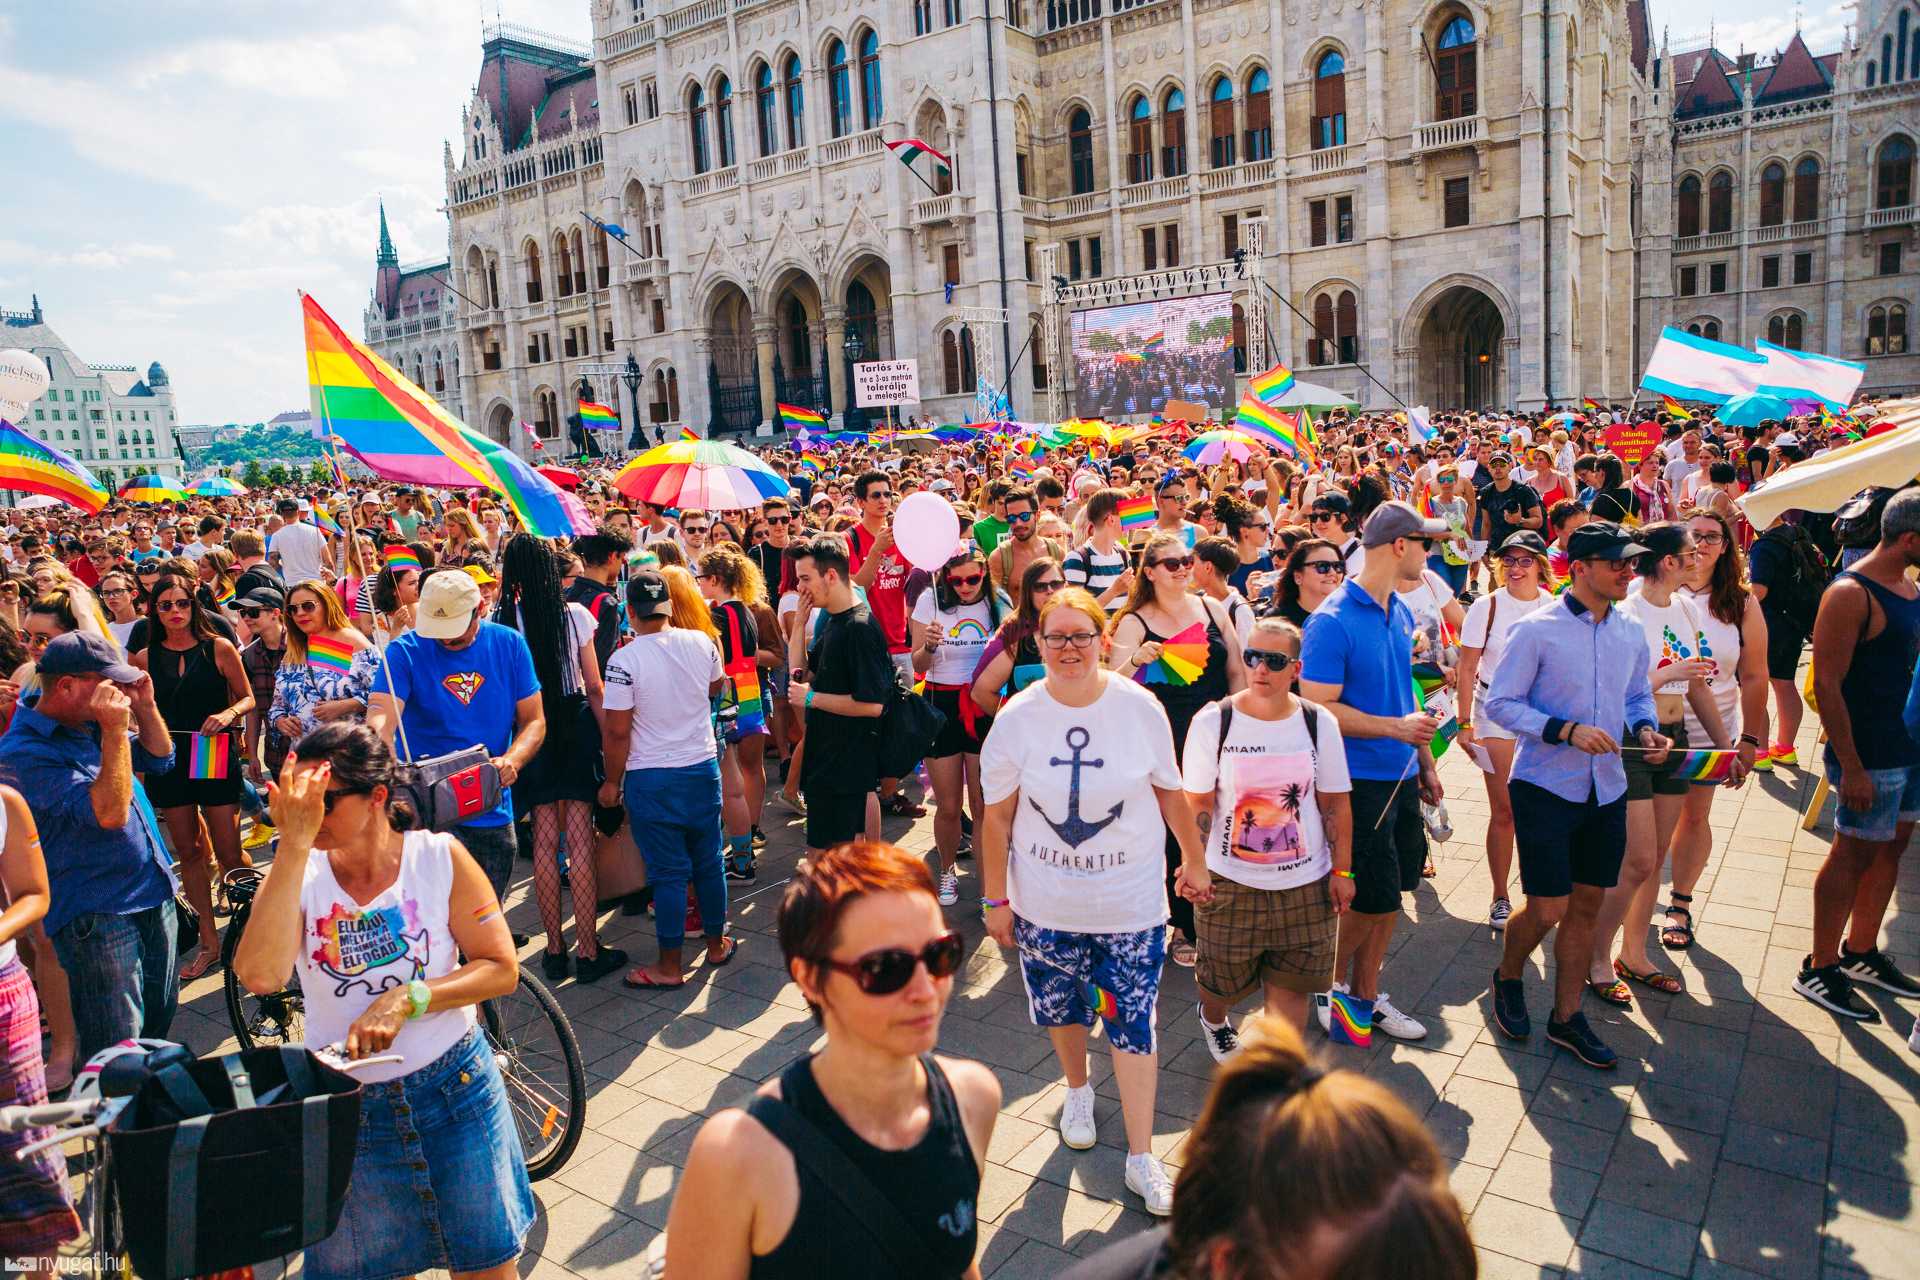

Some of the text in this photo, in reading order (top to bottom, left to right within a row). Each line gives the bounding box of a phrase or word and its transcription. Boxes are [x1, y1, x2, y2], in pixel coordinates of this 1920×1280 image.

[861, 363, 892, 373] Tarlós
[1223, 745, 1266, 753] MIAMI
[1222, 815, 1233, 856] MIAMI
[1030, 843, 1126, 869] AUTHENTIC
